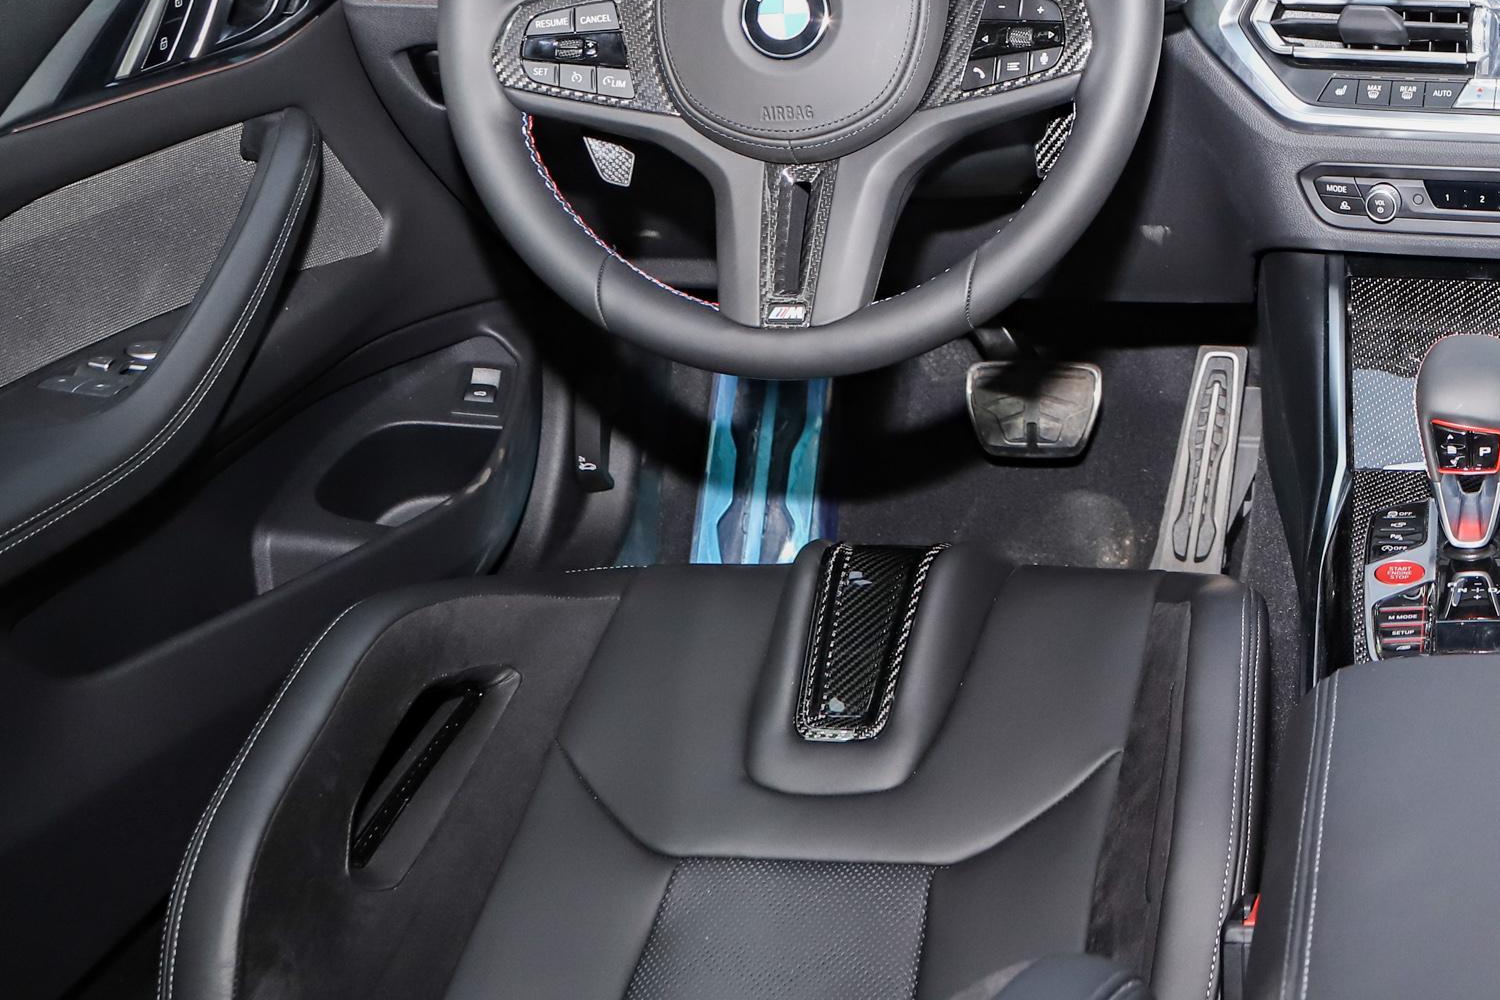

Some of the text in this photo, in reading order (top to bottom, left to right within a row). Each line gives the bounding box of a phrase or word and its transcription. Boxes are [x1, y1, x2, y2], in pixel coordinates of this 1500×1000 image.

[535, 18, 569, 29] RESUME
[580, 14, 612, 25] CANCEL
[533, 67, 548, 76] SET
[611, 79, 626, 89] LIM
[1367, 84, 1382, 92] MAX
[1400, 85, 1417, 93] REAR
[1432, 89, 1453, 98] AUTO
[762, 104, 814, 121] AIRBAG
[1326, 183, 1347, 194] MODE
[1374, 199, 1386, 207] VOL
[1479, 195, 1486, 204] 2
[1479, 446, 1491, 457] P
